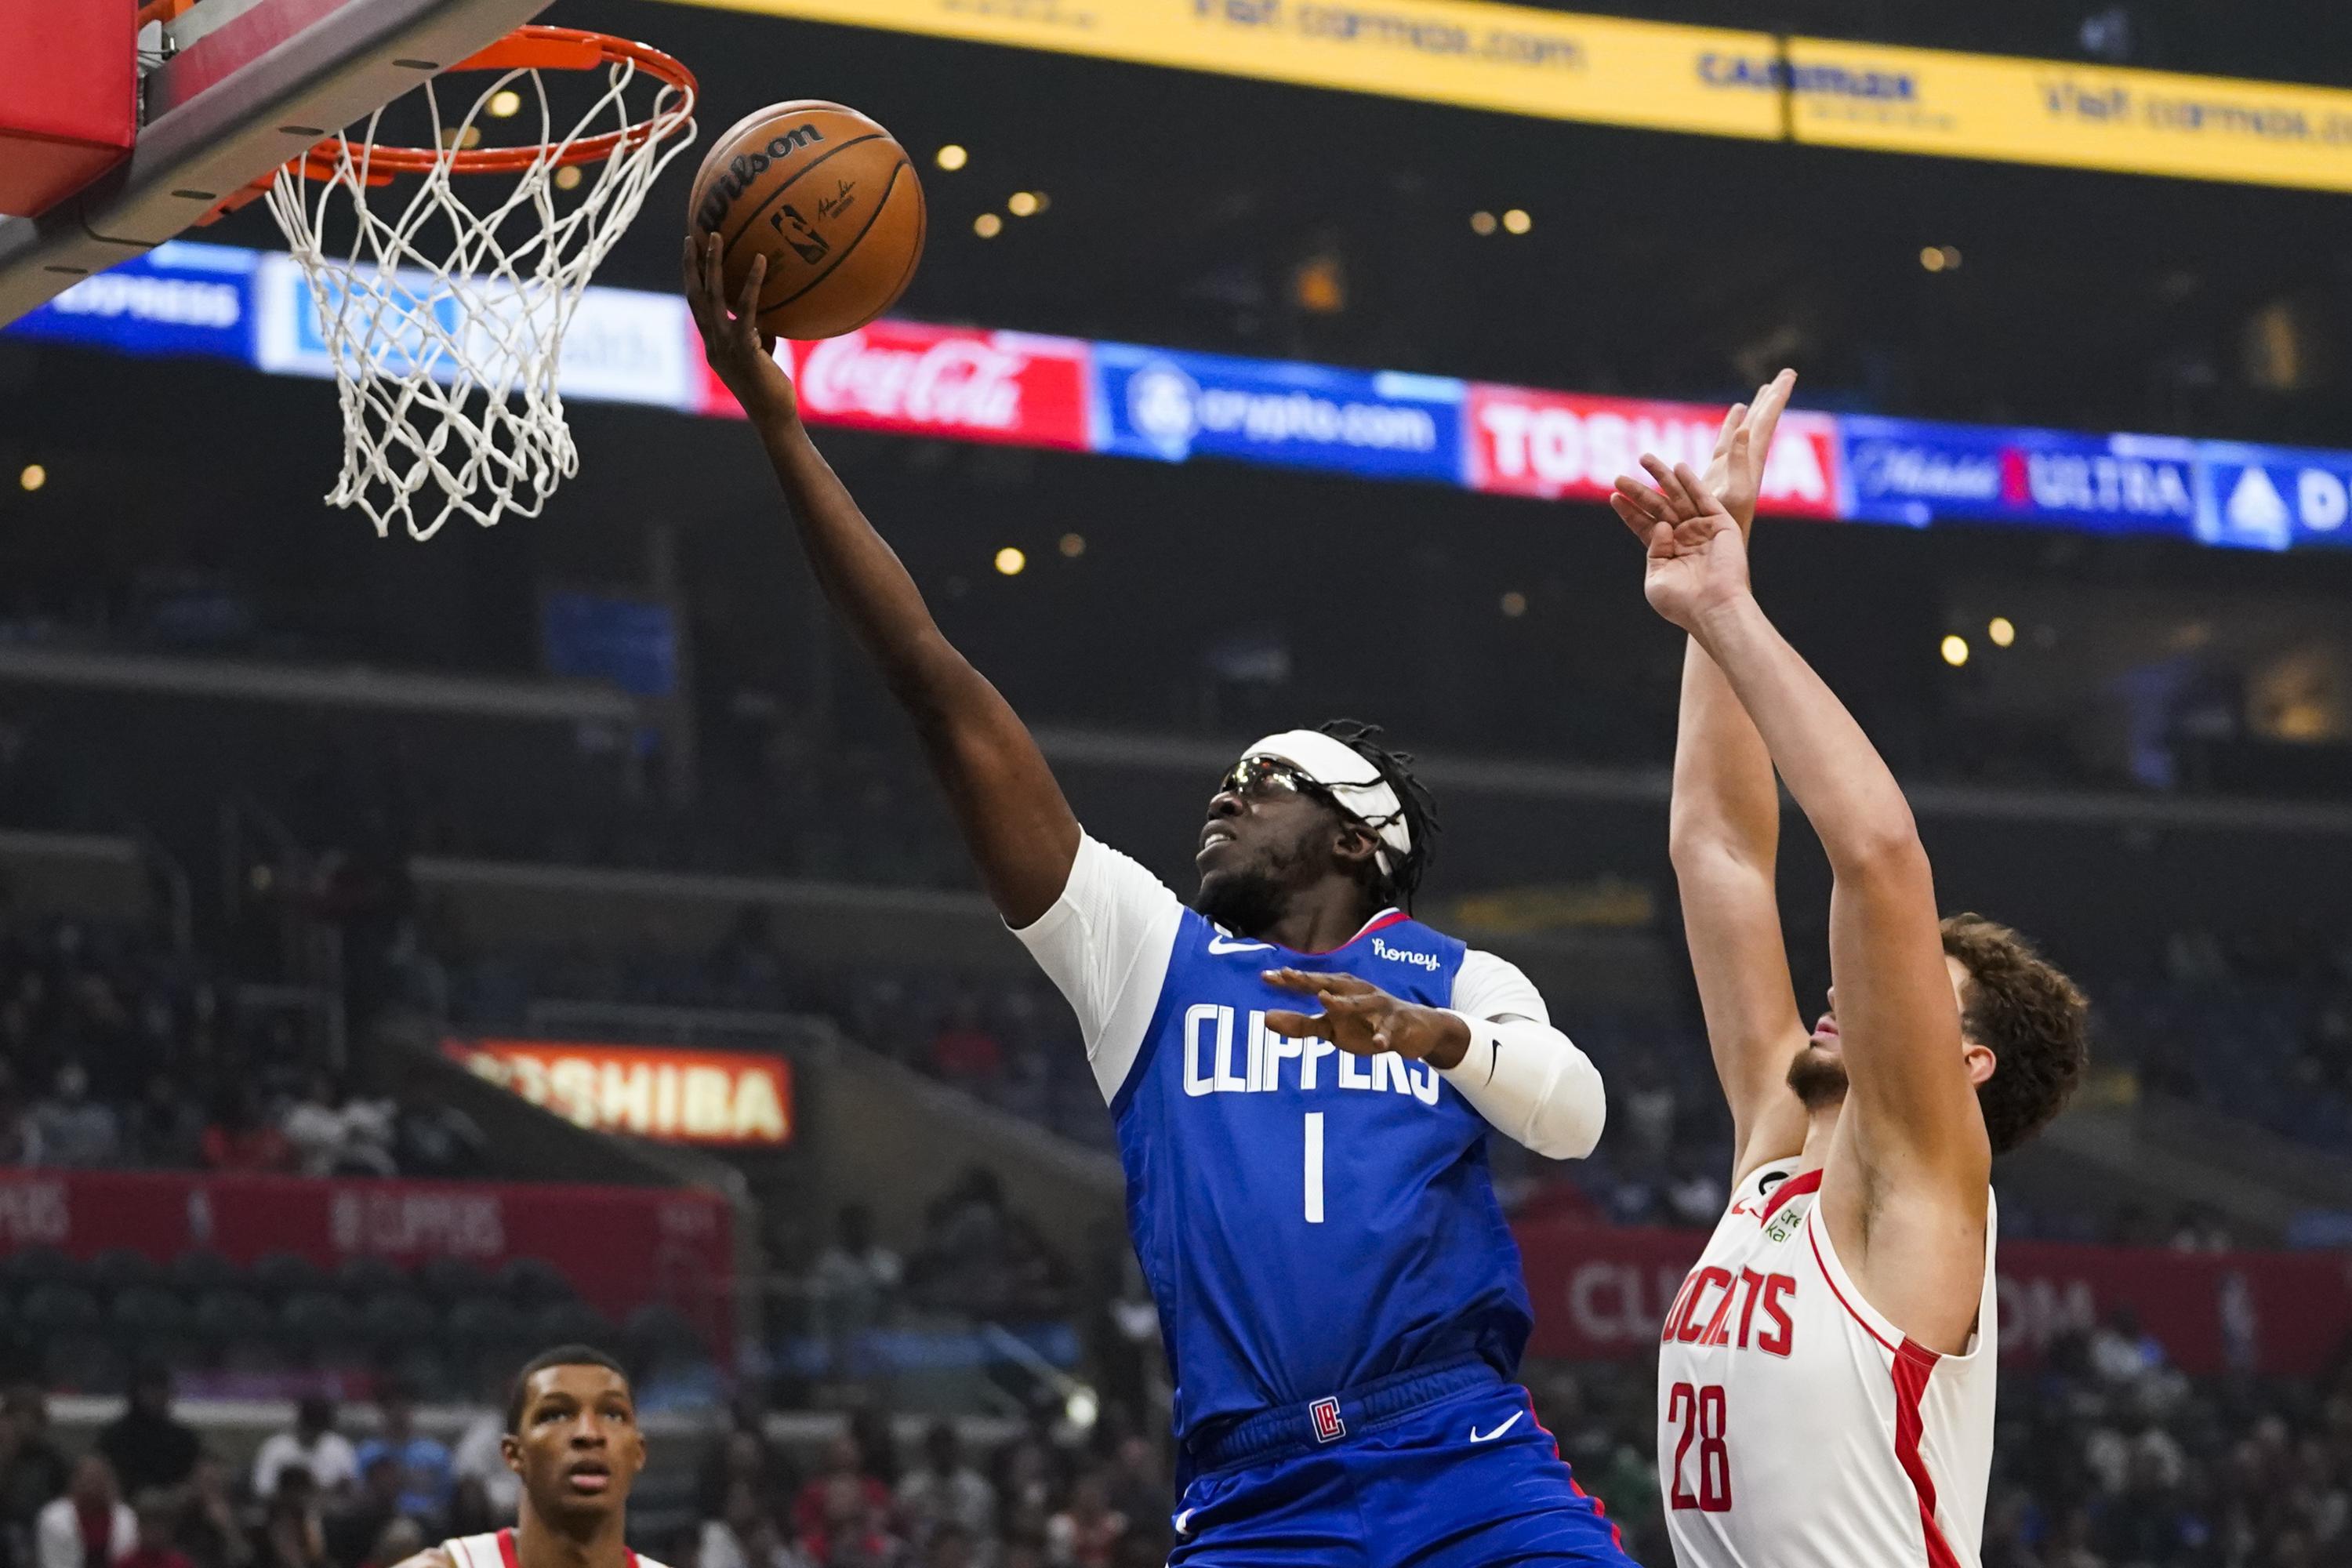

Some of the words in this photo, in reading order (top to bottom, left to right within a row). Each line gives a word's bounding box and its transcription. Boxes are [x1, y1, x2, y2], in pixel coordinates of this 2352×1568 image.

[1480, 401, 1828, 503] TOSHIA
[1371, 938, 1441, 971] honey
[1305, 1111, 1325, 1223] 1
[1668, 1382, 1733, 1512] 28
